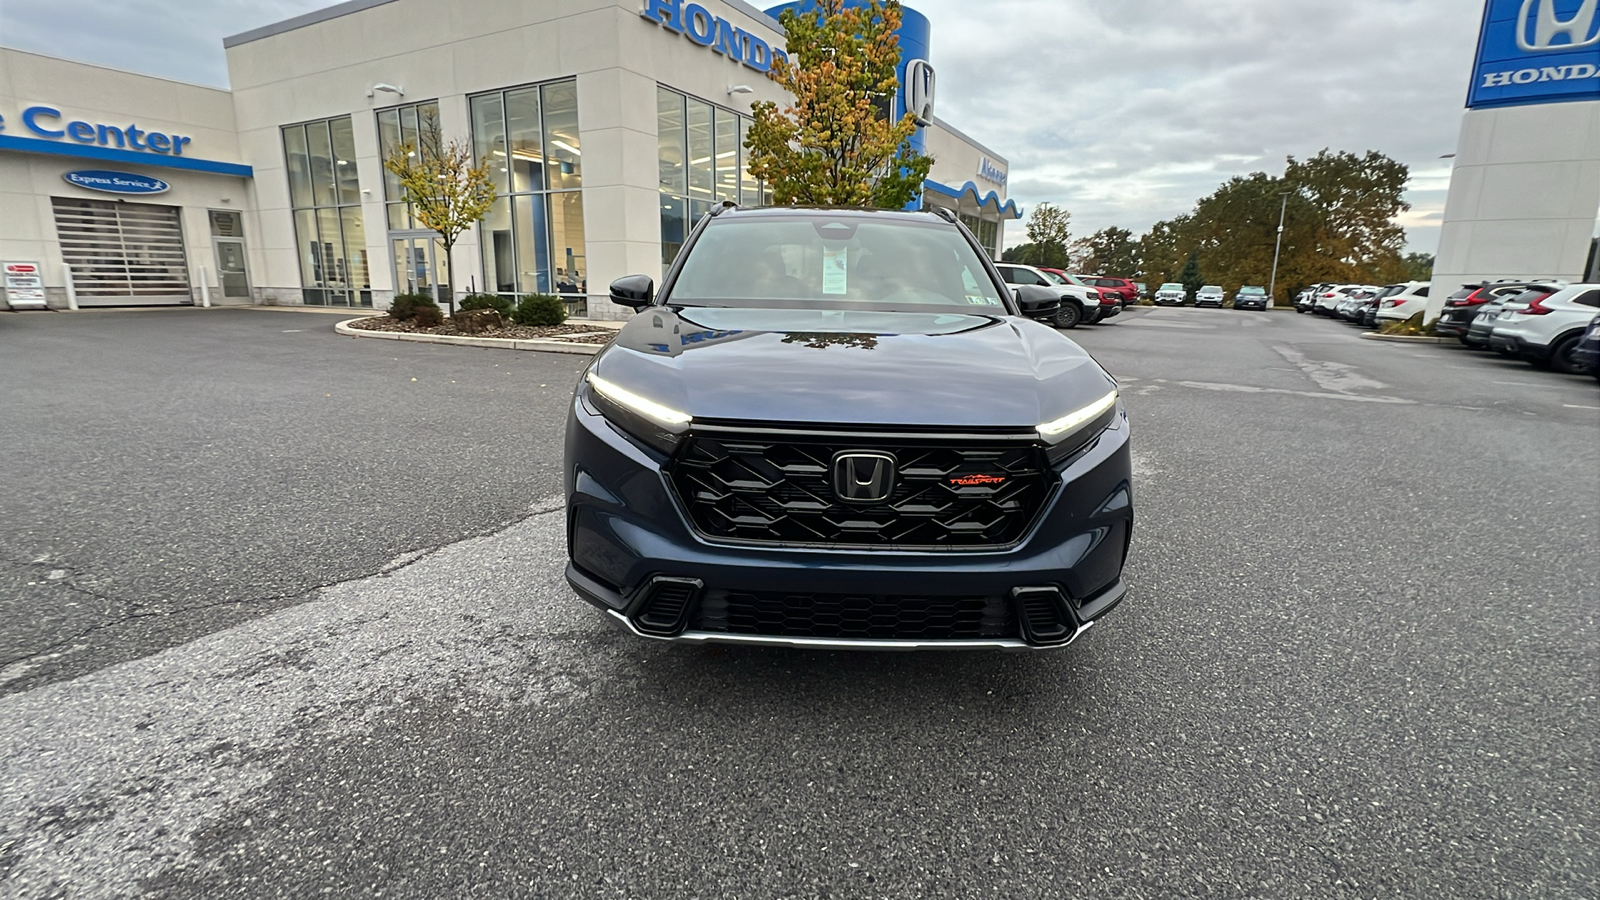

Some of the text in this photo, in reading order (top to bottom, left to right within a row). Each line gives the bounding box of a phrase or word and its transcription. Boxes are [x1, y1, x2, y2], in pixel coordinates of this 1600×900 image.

[1481, 64, 1600, 88] HOND
[22, 106, 191, 155] Center
[70, 173, 150, 188] Express Service
